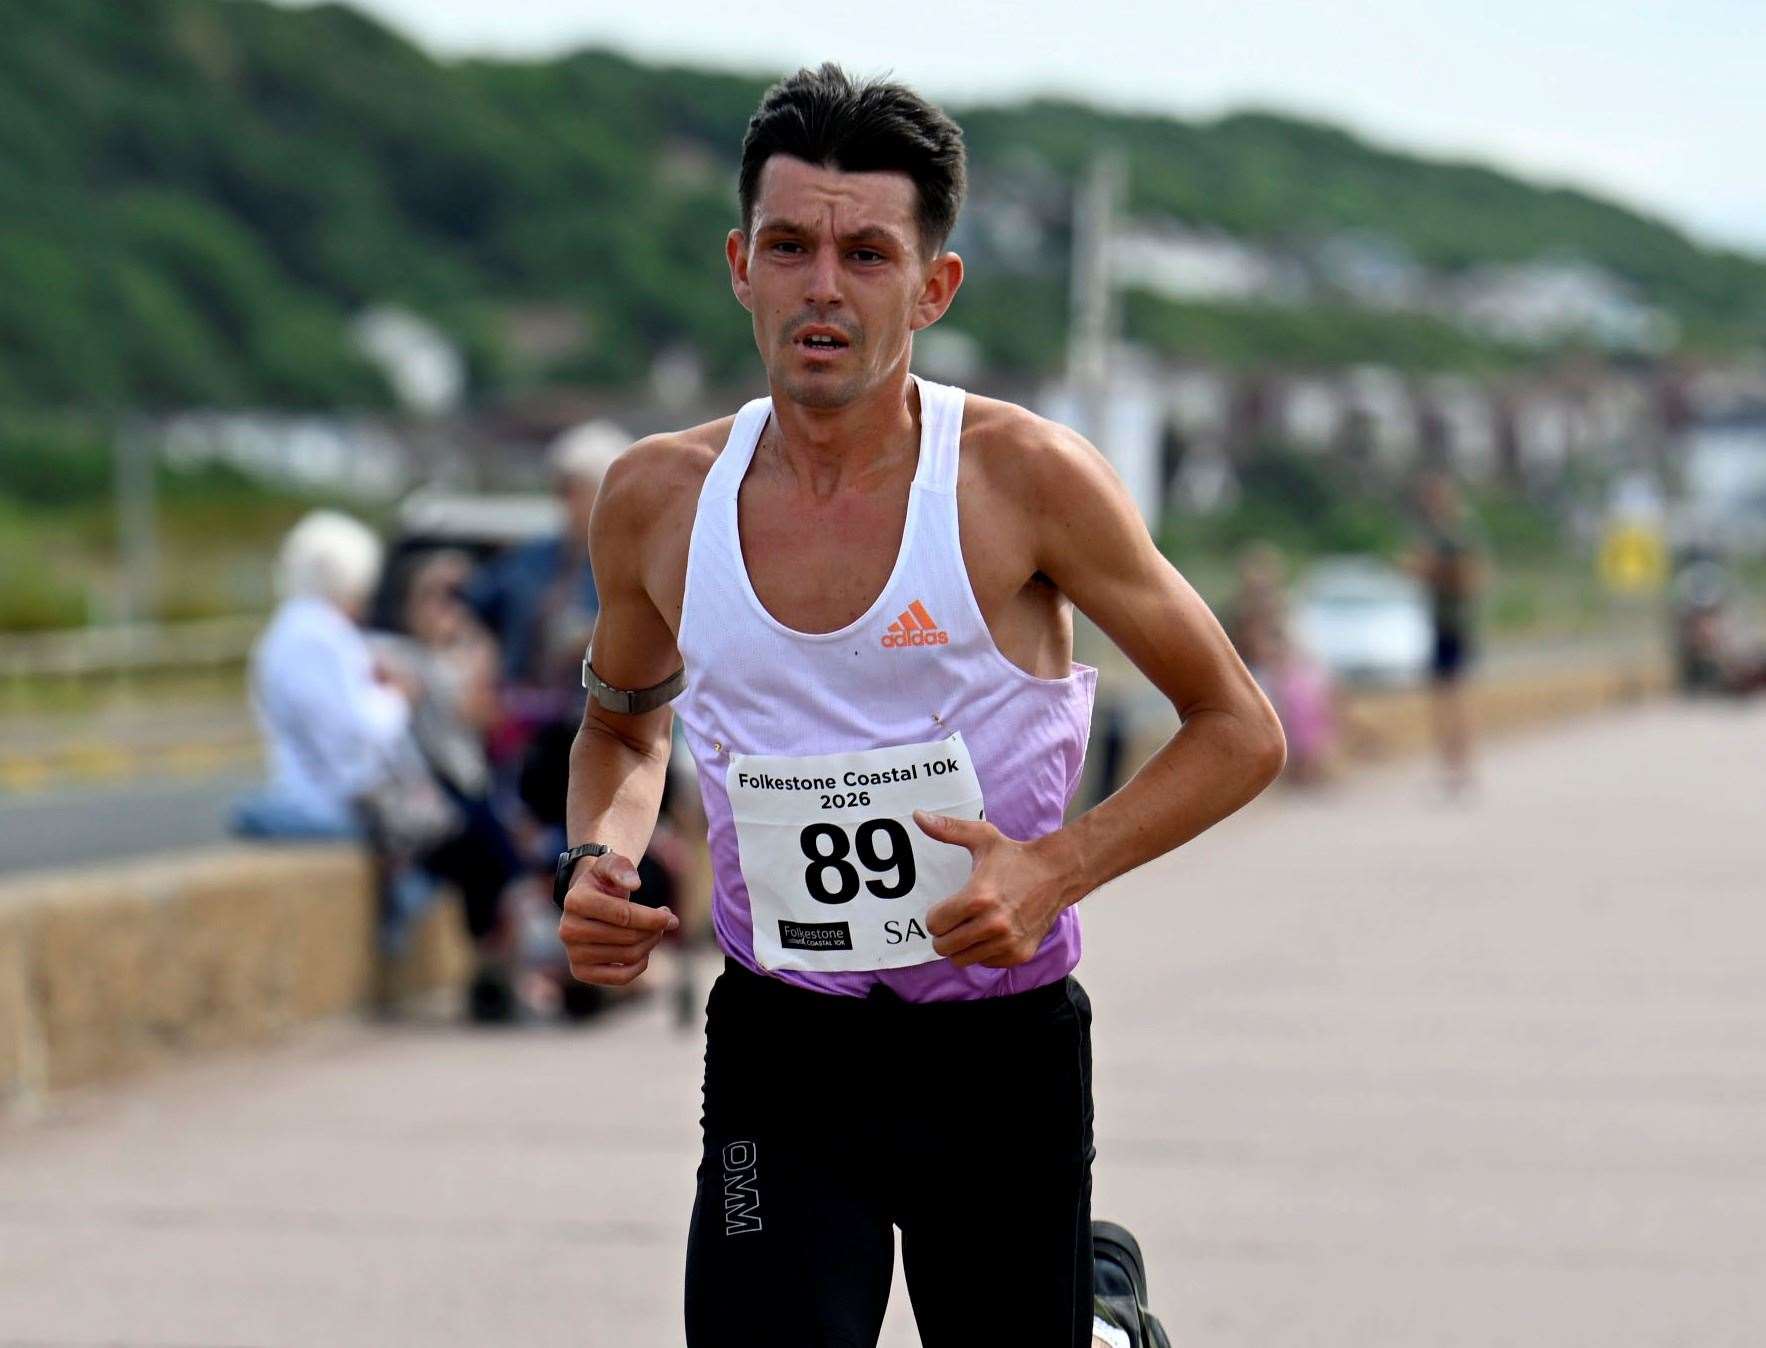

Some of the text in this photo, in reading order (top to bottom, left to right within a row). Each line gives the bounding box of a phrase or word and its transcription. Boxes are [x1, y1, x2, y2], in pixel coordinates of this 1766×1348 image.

[881, 628, 949, 648] adidas
[738, 758, 959, 791] Folkestone Coastal 10k
[820, 791, 871, 809] 2026
[800, 818, 916, 905] 89
[784, 925, 844, 939] Folkestone
[722, 1140, 763, 1236] OMM
